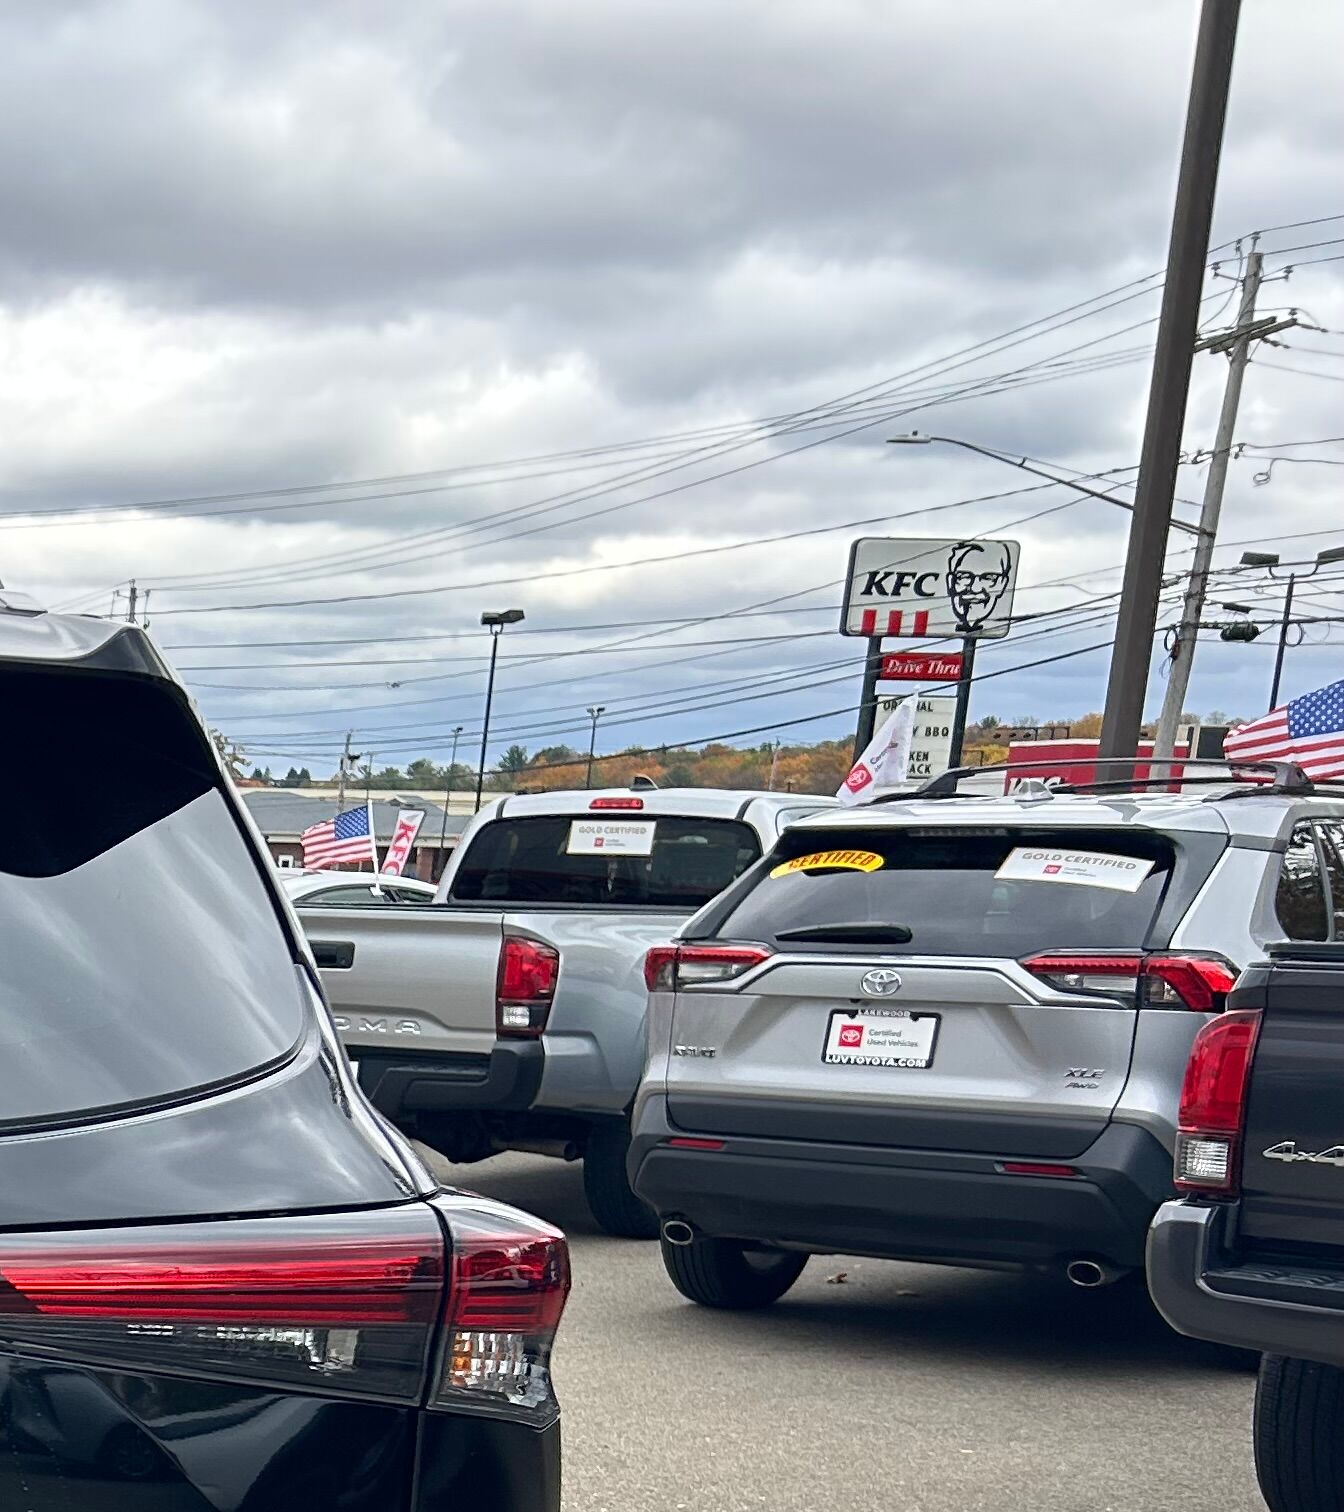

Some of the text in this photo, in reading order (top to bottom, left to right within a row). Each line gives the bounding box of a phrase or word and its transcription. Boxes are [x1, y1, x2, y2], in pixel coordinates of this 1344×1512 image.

[860, 570, 939, 597] KFC
[886, 658, 961, 674] Drive Thru
[924, 726, 950, 737] BBQ
[788, 850, 877, 869] CERTIFIED
[1021, 852, 1138, 870] GOLD CERTIFIED
[332, 1015, 421, 1035] OMA
[824, 1053, 927, 1069] LUVTOYOTA.COM
[1063, 1066, 1105, 1080] XLE
